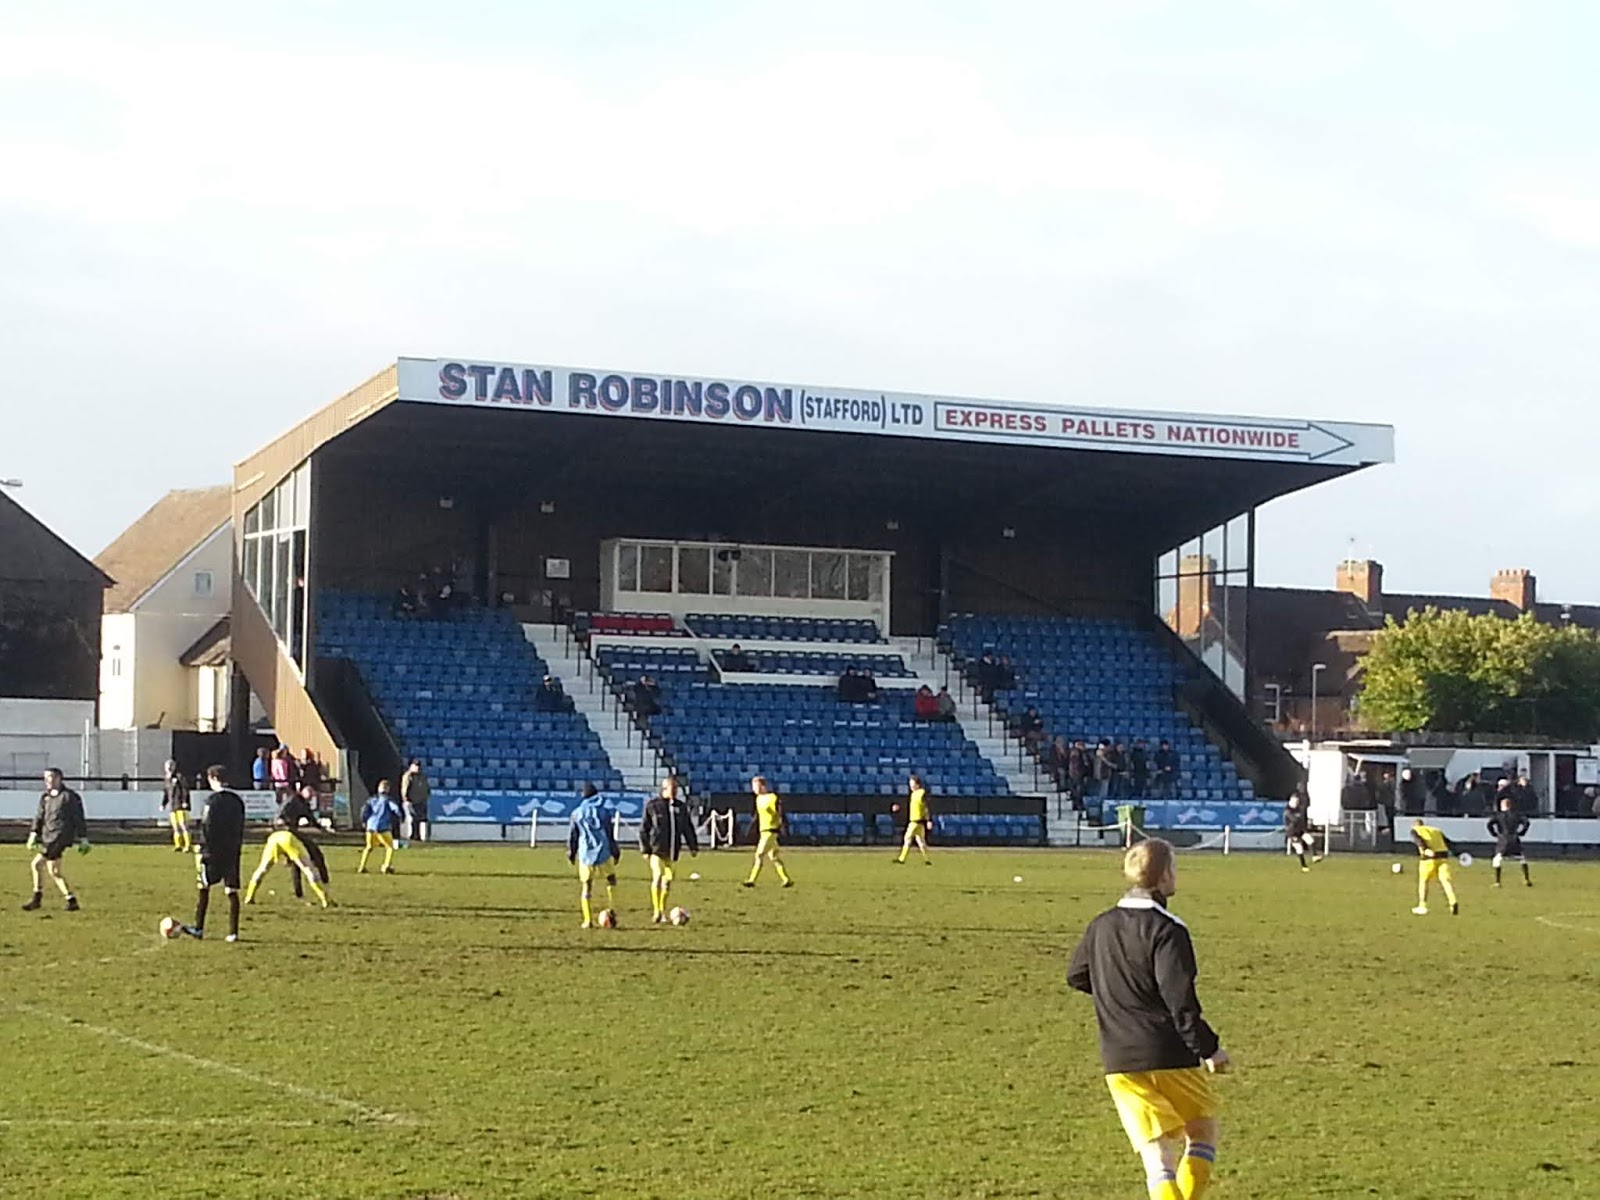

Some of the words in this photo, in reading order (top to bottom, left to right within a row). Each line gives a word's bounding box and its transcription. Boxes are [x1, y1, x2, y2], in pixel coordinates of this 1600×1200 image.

[439, 362, 553, 407] STAN
[568, 371, 793, 424] ROBINSON
[800, 389, 885, 429] (STAFFORD)
[891, 403, 924, 426] LTD
[945, 408, 1047, 432] EXPRESS
[1061, 418, 1155, 440] PALLETS
[1167, 425, 1299, 449] NATIONWIDE
